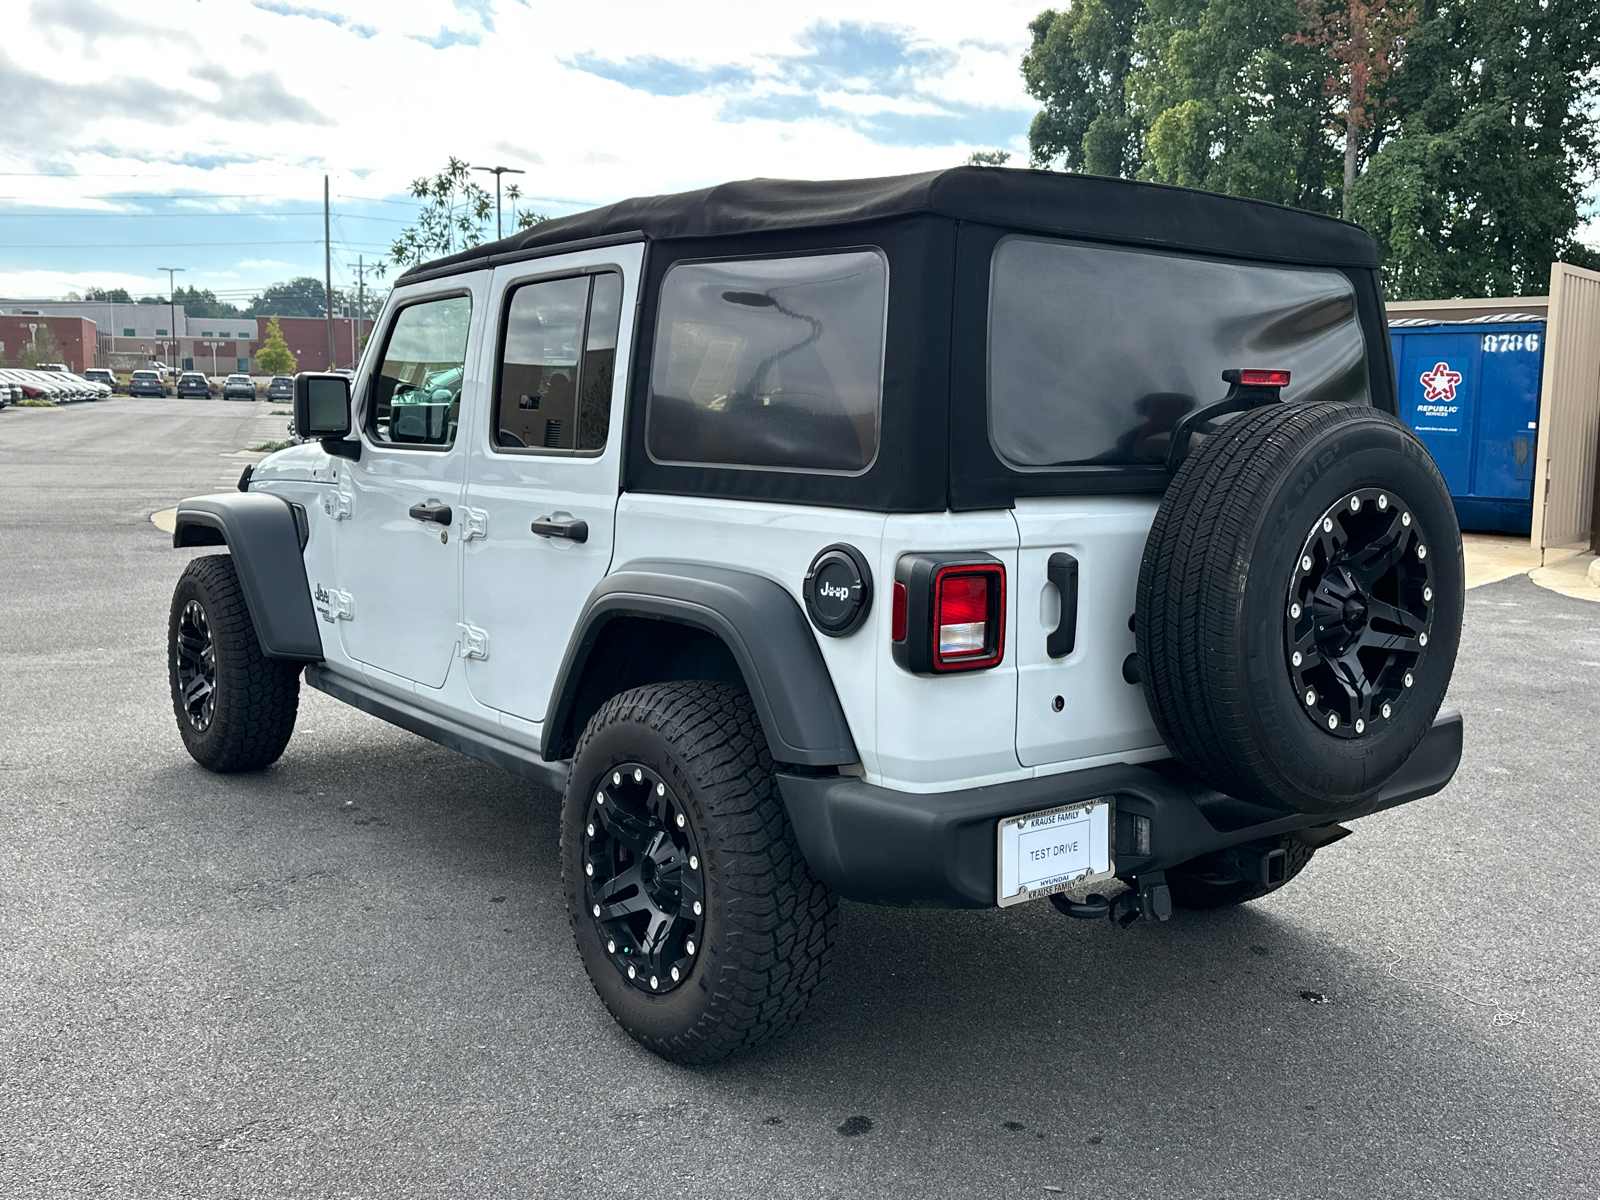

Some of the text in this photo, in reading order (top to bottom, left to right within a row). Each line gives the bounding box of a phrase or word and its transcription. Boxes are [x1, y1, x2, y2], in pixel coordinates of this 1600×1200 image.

[1483, 333, 1539, 352] 8786
[1417, 404, 1458, 413] REPUBLIC
[315, 582, 330, 605] Jee
[820, 581, 849, 601] Jeep
[1031, 810, 1080, 828] KRAUSE FAMILY
[1030, 841, 1078, 861] TEST DRIVE
[1028, 881, 1076, 900] KRAUSE FAMILY
[1040, 875, 1070, 887] HYUNDAI
